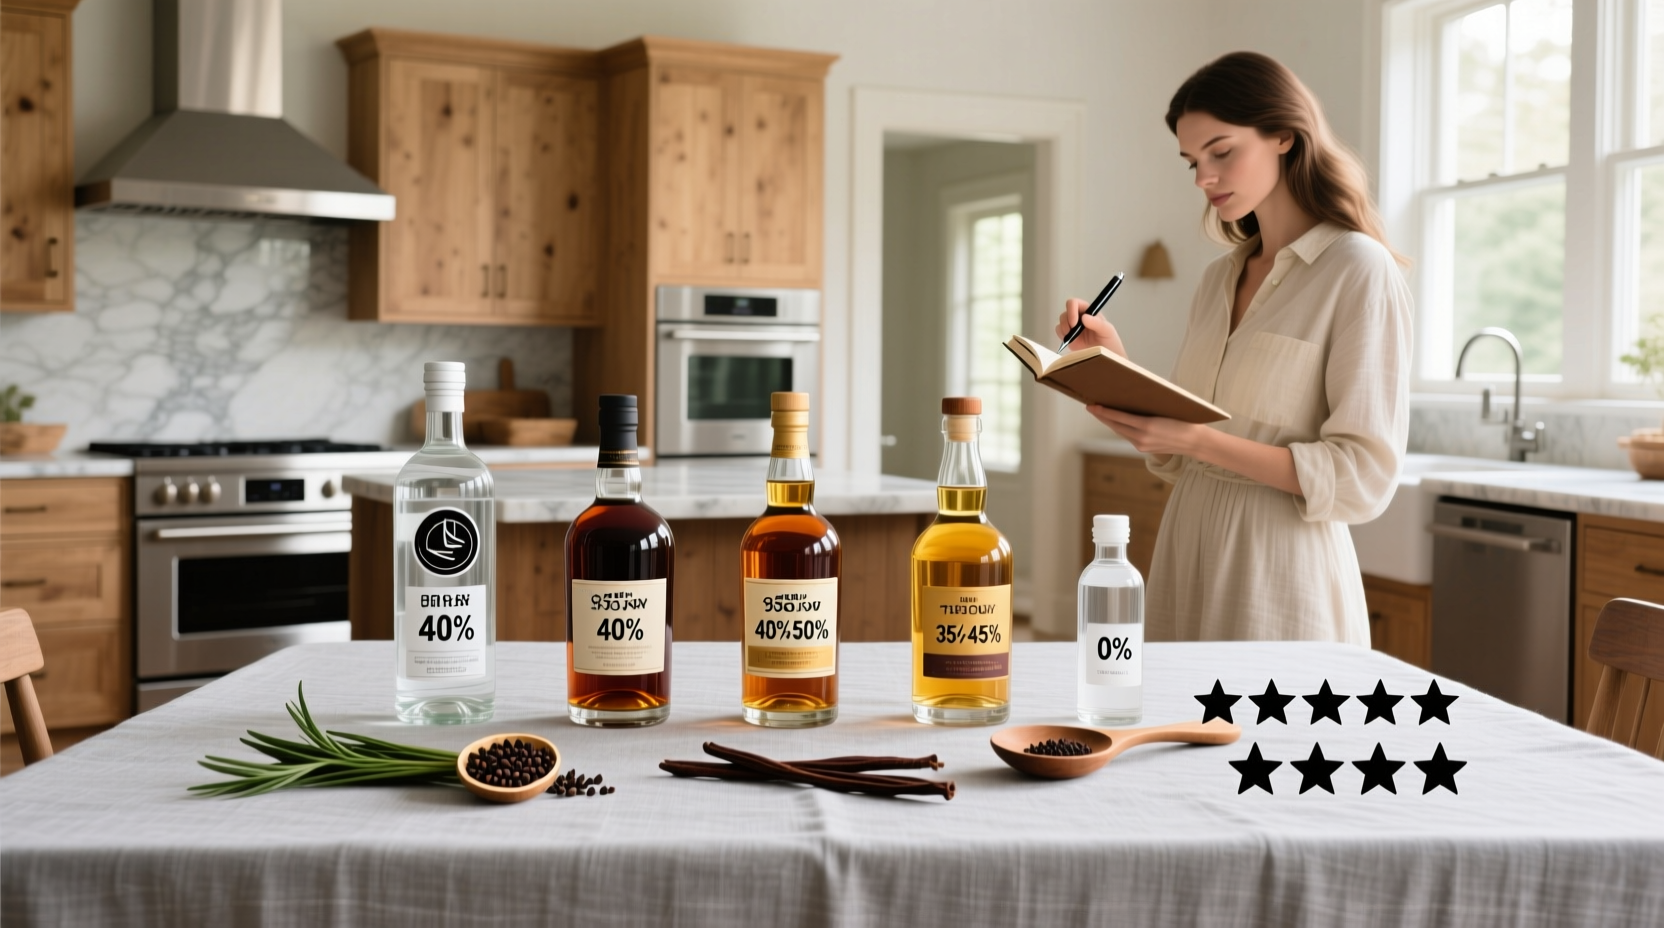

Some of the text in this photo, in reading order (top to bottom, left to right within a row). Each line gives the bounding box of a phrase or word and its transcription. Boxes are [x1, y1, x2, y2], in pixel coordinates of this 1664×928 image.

[418, 614, 475, 642] 40%
[596, 618, 644, 641] 40%
[1097, 636, 1133, 661] 0%
